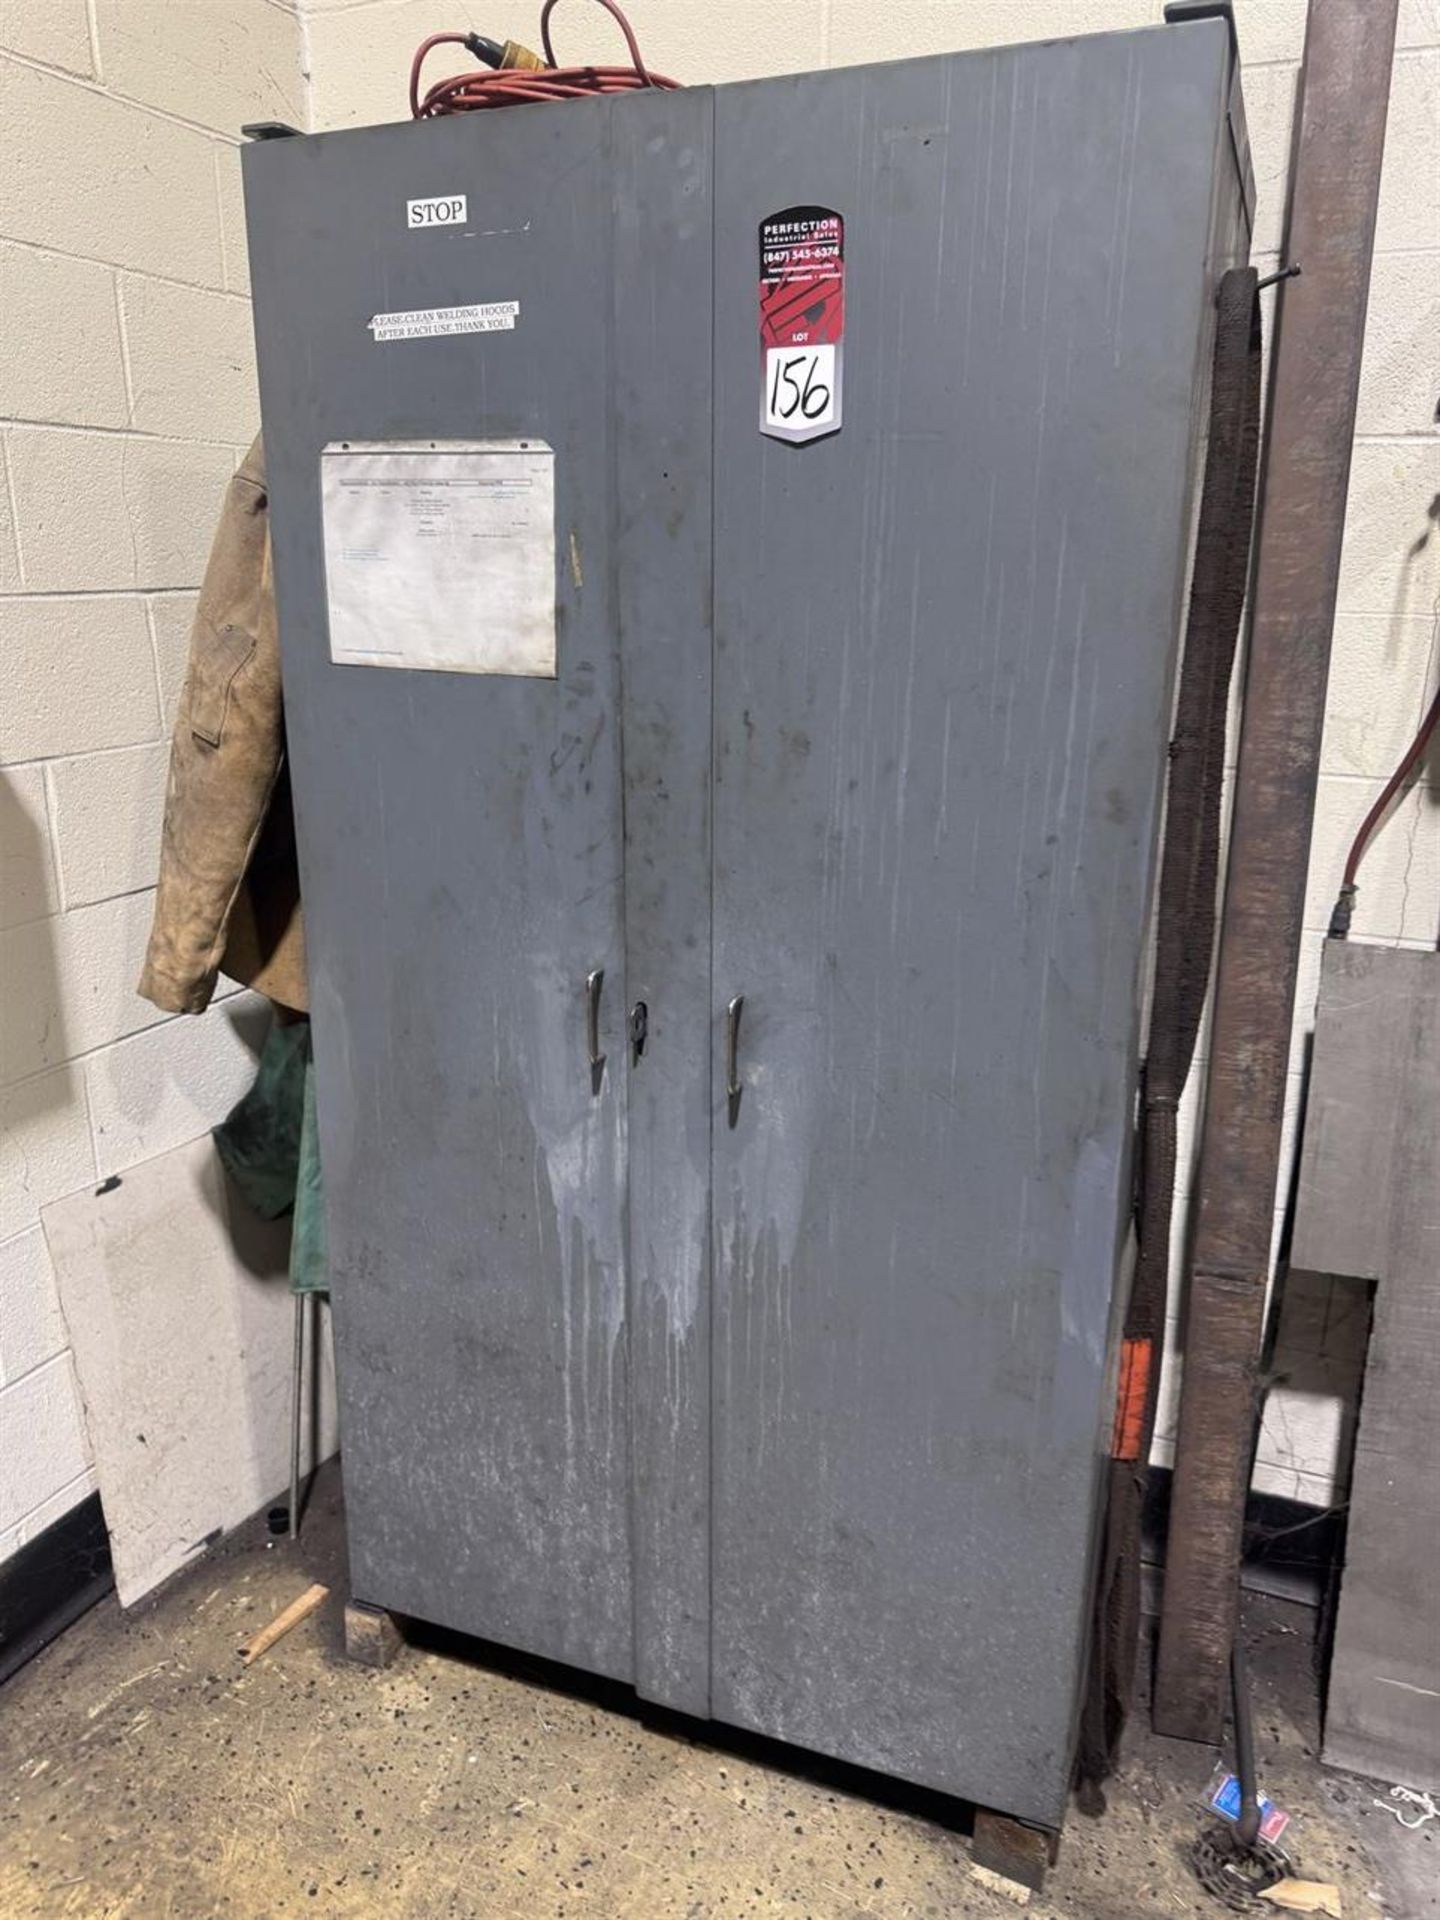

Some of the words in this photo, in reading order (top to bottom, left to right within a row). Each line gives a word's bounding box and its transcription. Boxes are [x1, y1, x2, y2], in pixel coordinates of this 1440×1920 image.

[411, 201, 463, 224] STOP
[764, 219, 839, 235] PERFECTION
[764, 233, 810, 243] Industrial
[814, 230, 839, 239] Sales
[763, 250, 790, 264] (847)
[436, 308, 479, 320] WELDING
[481, 304, 516, 316] HOODS
[377, 328, 405, 339] AFTER
[407, 325, 432, 336] EACH
[792, 333, 809, 342] LOT
[771, 356, 830, 419] 156
